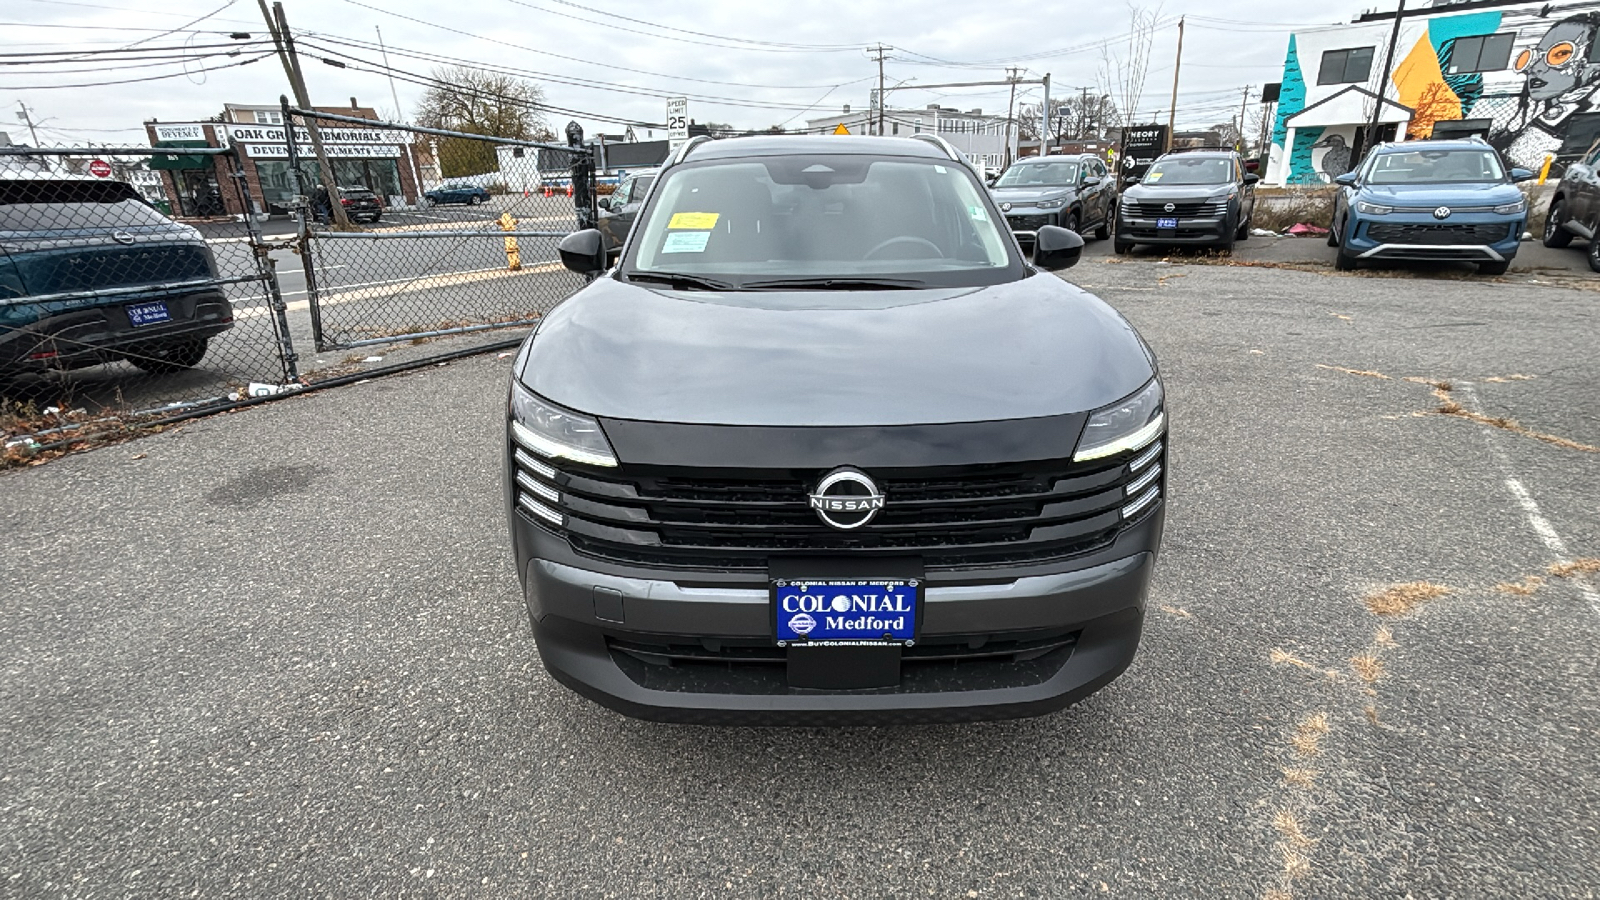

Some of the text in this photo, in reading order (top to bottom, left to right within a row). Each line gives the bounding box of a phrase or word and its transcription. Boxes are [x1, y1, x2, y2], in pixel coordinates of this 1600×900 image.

[669, 116, 686, 129] 25
[234, 129, 264, 140] OAK
[266, 129, 309, 141] GRVE
[252, 146, 304, 155] DEVENY
[308, 147, 371, 155] MNUMENTS
[811, 498, 884, 510] NISSAN
[782, 594, 911, 612] COLONIAL
[825, 616, 904, 630] Medford
